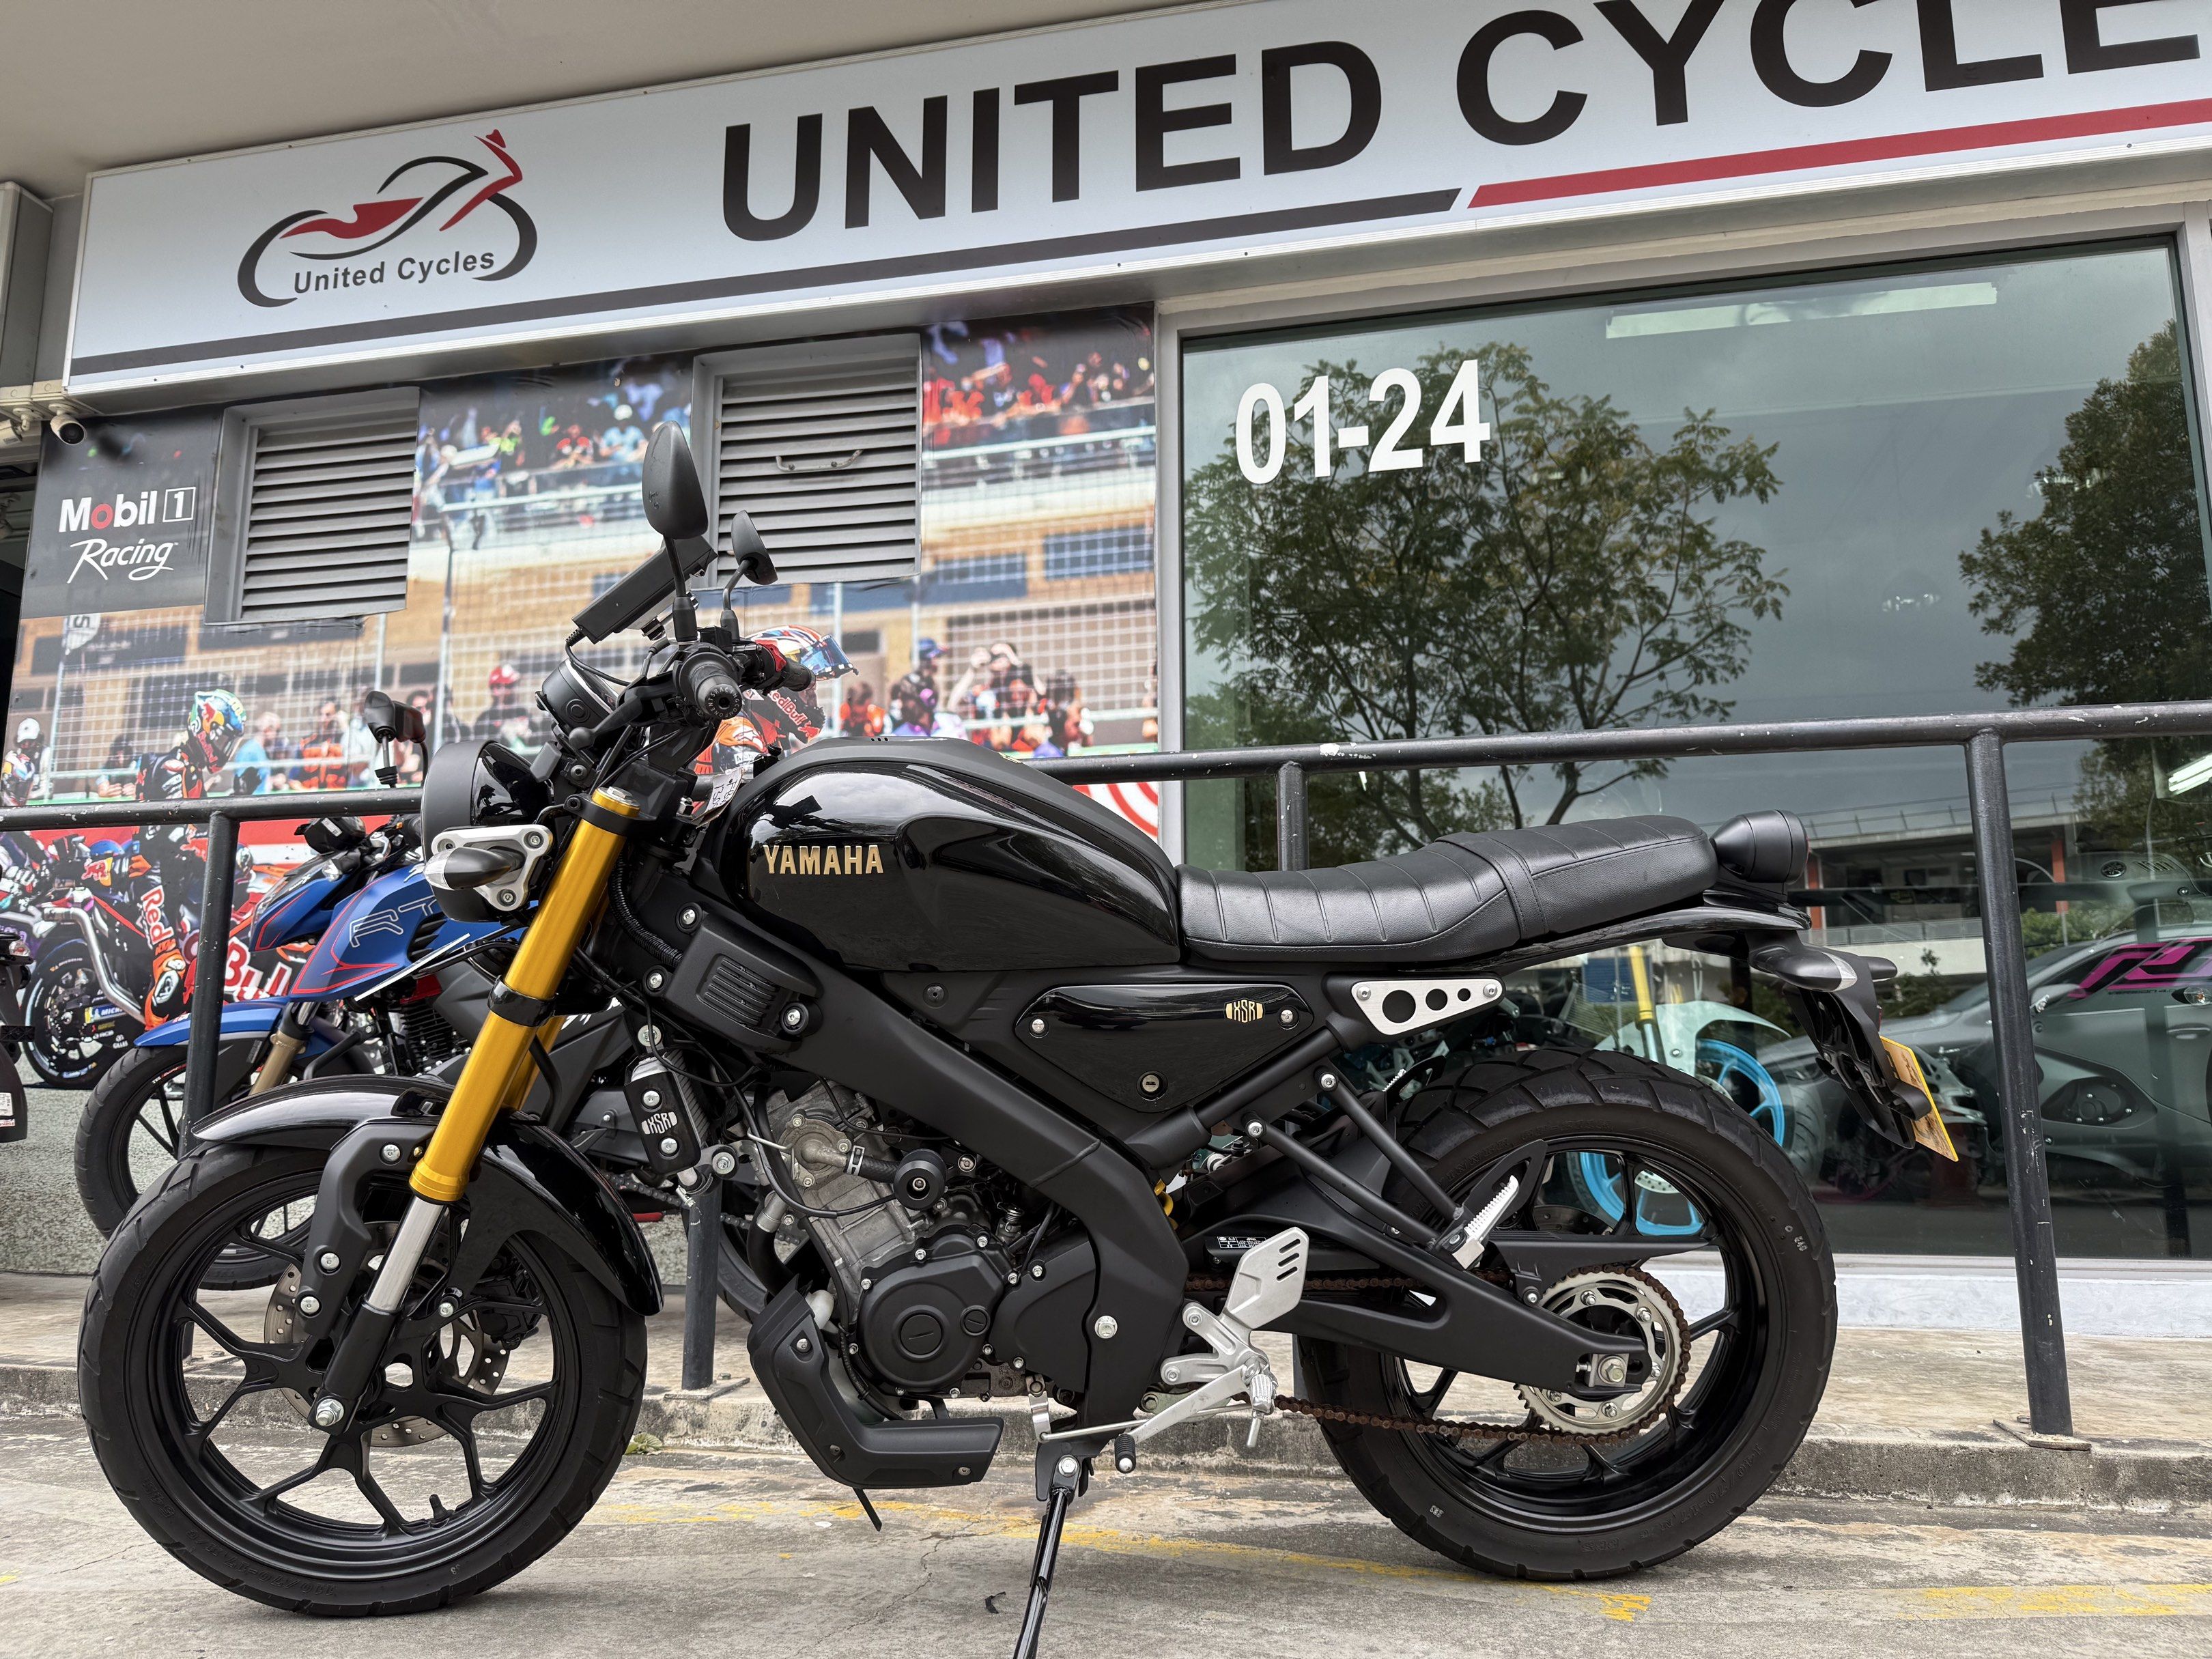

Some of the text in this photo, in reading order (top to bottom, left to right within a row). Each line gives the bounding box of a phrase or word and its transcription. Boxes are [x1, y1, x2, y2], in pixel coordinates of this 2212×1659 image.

[722, 0, 2200, 242] UNITED CYCLE
[294, 251, 495, 294] United Cycles
[1236, 359, 1491, 485] 01-24
[59, 490, 158, 533] Mobil
[67, 538, 175, 584] Racing
[763, 845, 883, 875] YAMAHA
[141, 885, 174, 946] Red
[224, 936, 293, 1002] Bul
[101, 1007, 123, 1016] MICH
[1232, 999, 1256, 1023] XSR
[646, 1111, 672, 1135] XSR
